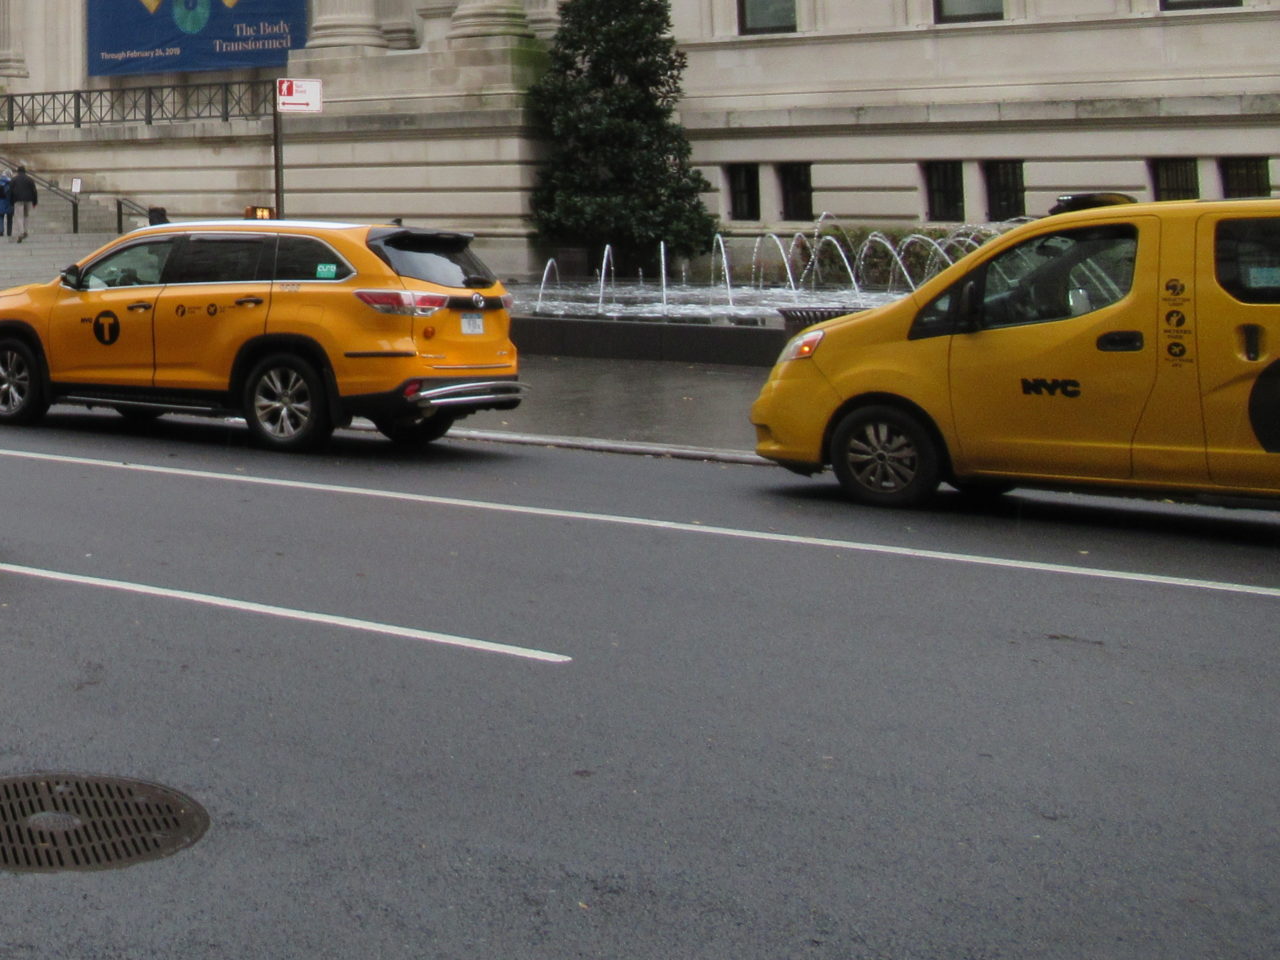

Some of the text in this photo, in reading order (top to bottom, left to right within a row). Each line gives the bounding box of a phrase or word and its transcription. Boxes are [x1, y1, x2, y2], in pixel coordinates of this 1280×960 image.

[233, 20, 291, 37] The Body
[213, 35, 292, 53] Transformed
[100, 51, 127, 61] Through
[127, 49, 155, 60] February
[166, 47, 181, 56] 2019
[1021, 378, 1081, 398] NYC
